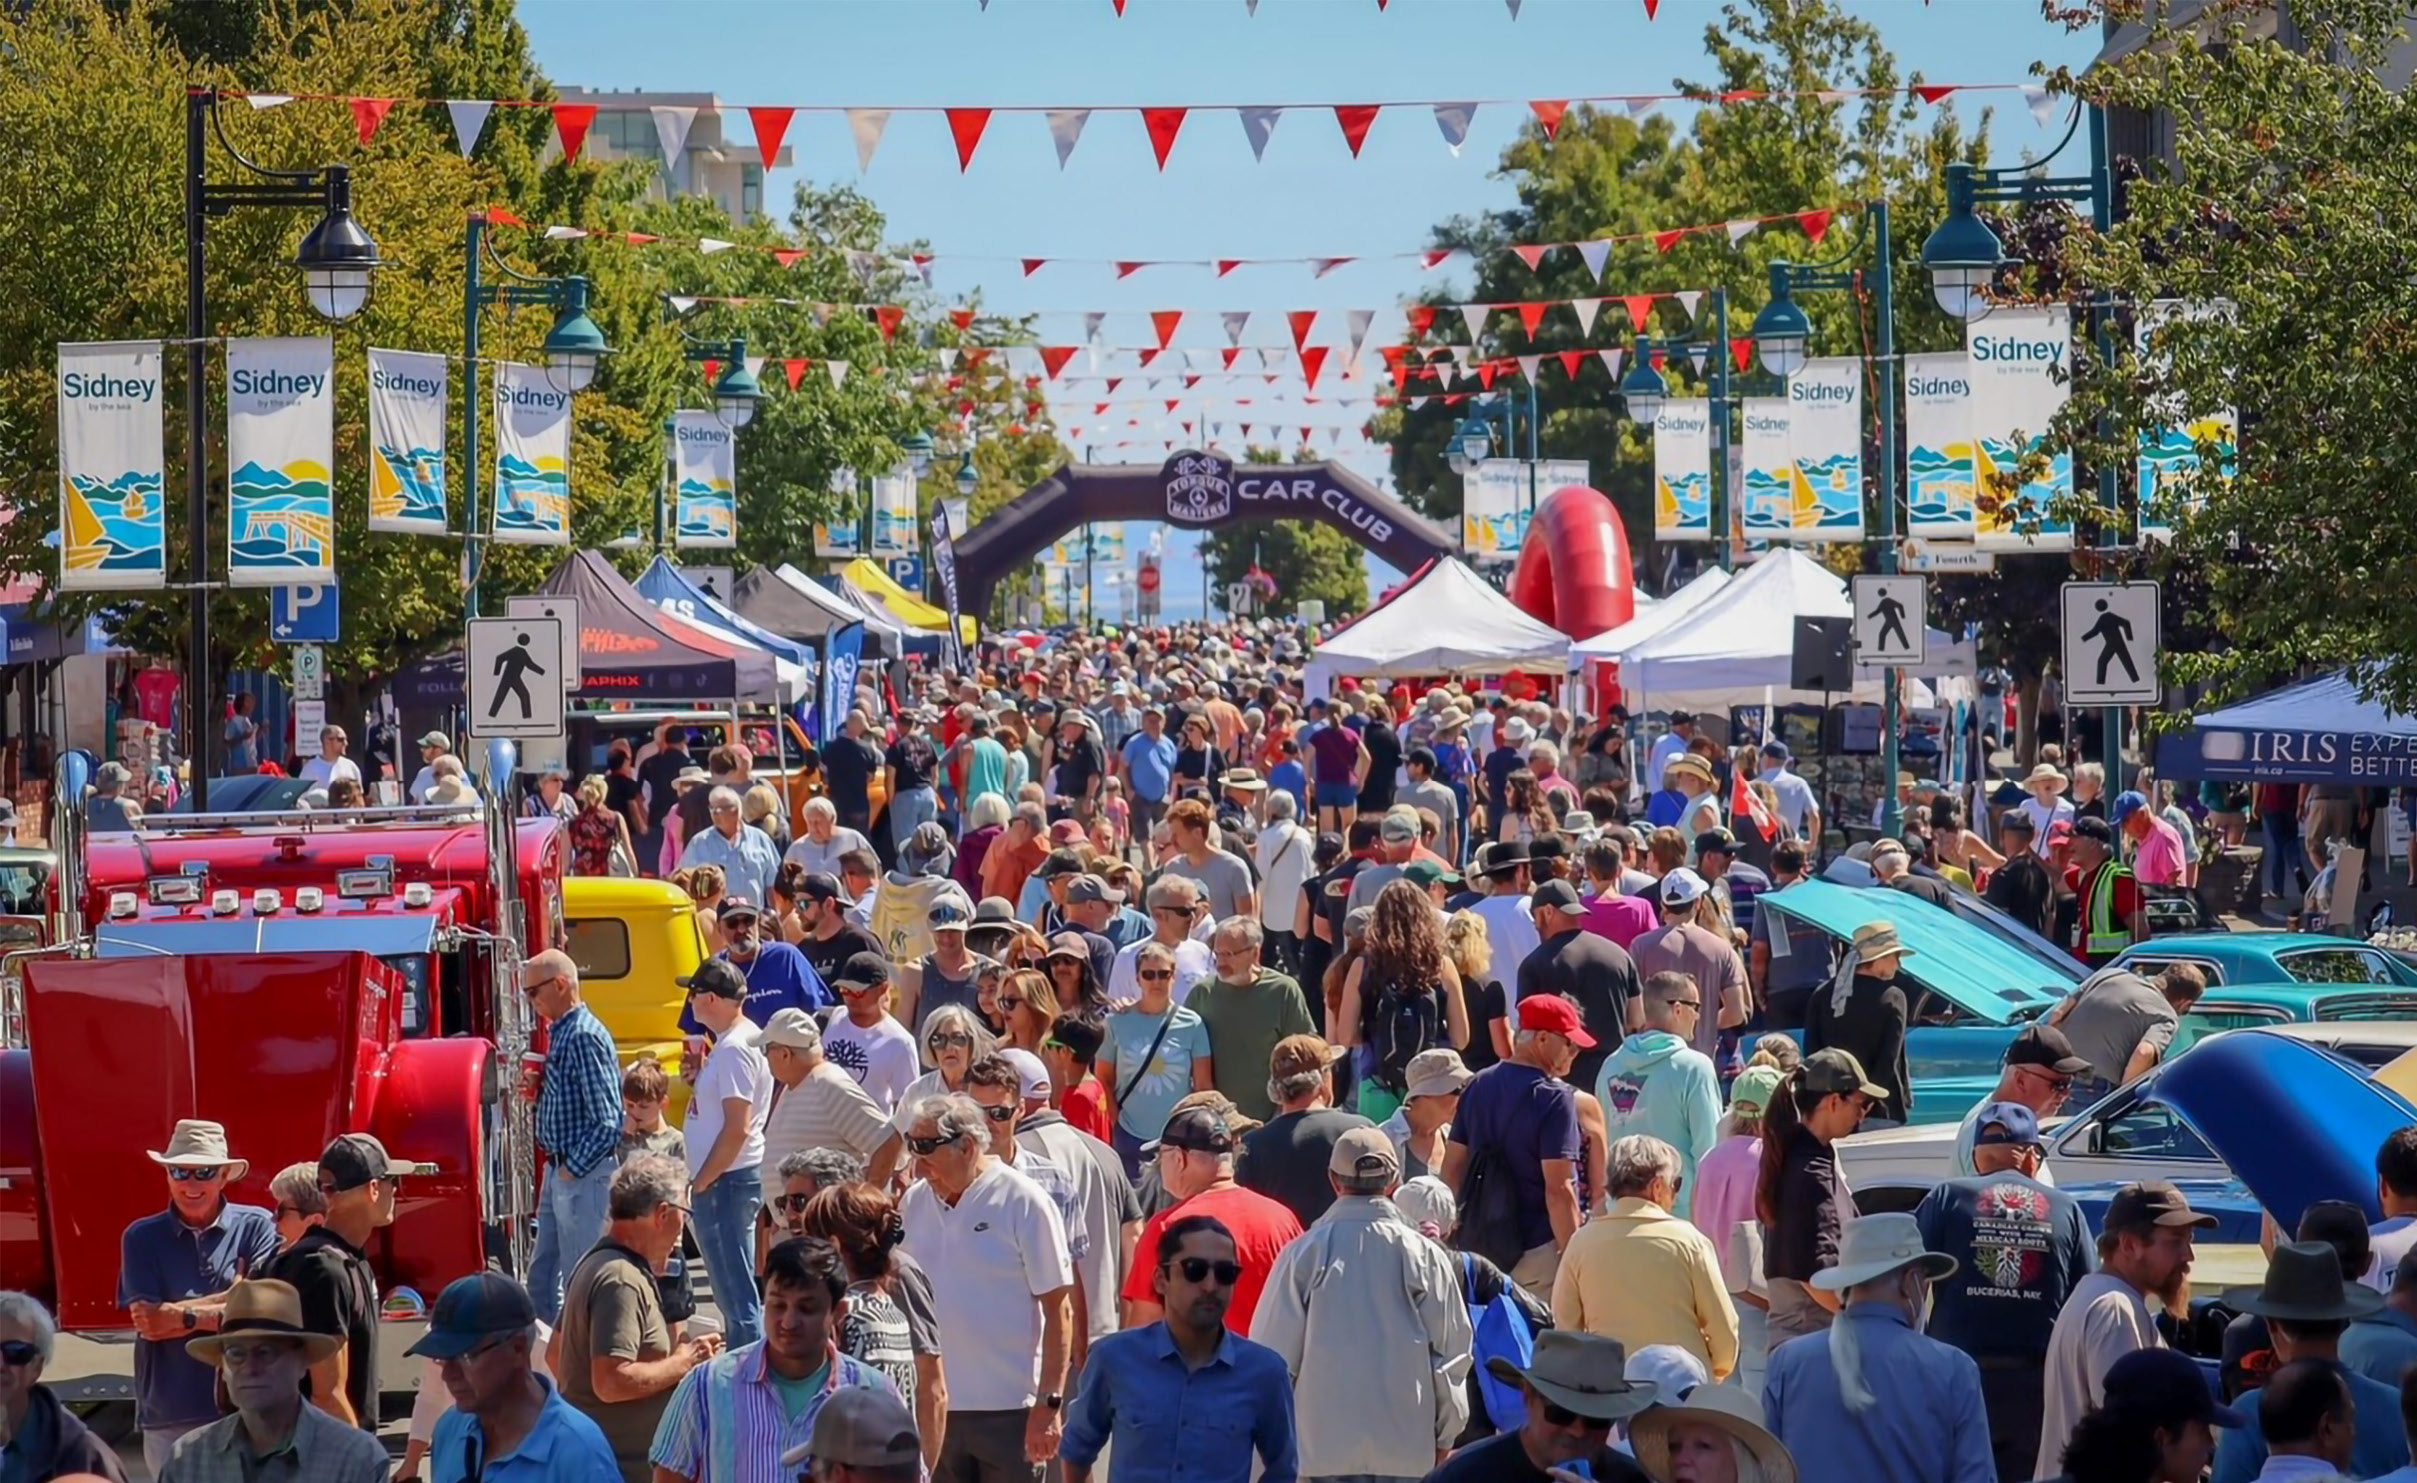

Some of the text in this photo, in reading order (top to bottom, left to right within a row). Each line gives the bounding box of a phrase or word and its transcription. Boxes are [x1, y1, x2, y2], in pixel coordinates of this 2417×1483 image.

[1973, 336, 2064, 363] Sidney
[64, 373, 155, 402] Sidney
[232, 369, 325, 398] Sidney
[373, 371, 441, 397] Sidney
[1791, 382, 1855, 403] Sidney
[497, 384, 567, 411] Sidney
[678, 426, 731, 444] Sidney
[1657, 415, 1706, 437] Sidney
[1745, 416, 1789, 431] Sidne
[1238, 479, 1394, 543] CAR CLUB
[894, 561, 914, 586] P
[287, 581, 323, 621] P
[647, 597, 695, 619] AS
[304, 656, 313, 668] P
[418, 682, 459, 693] FOLL
[580, 675, 640, 687] APHIX
[2251, 732, 2337, 763] IRIS
